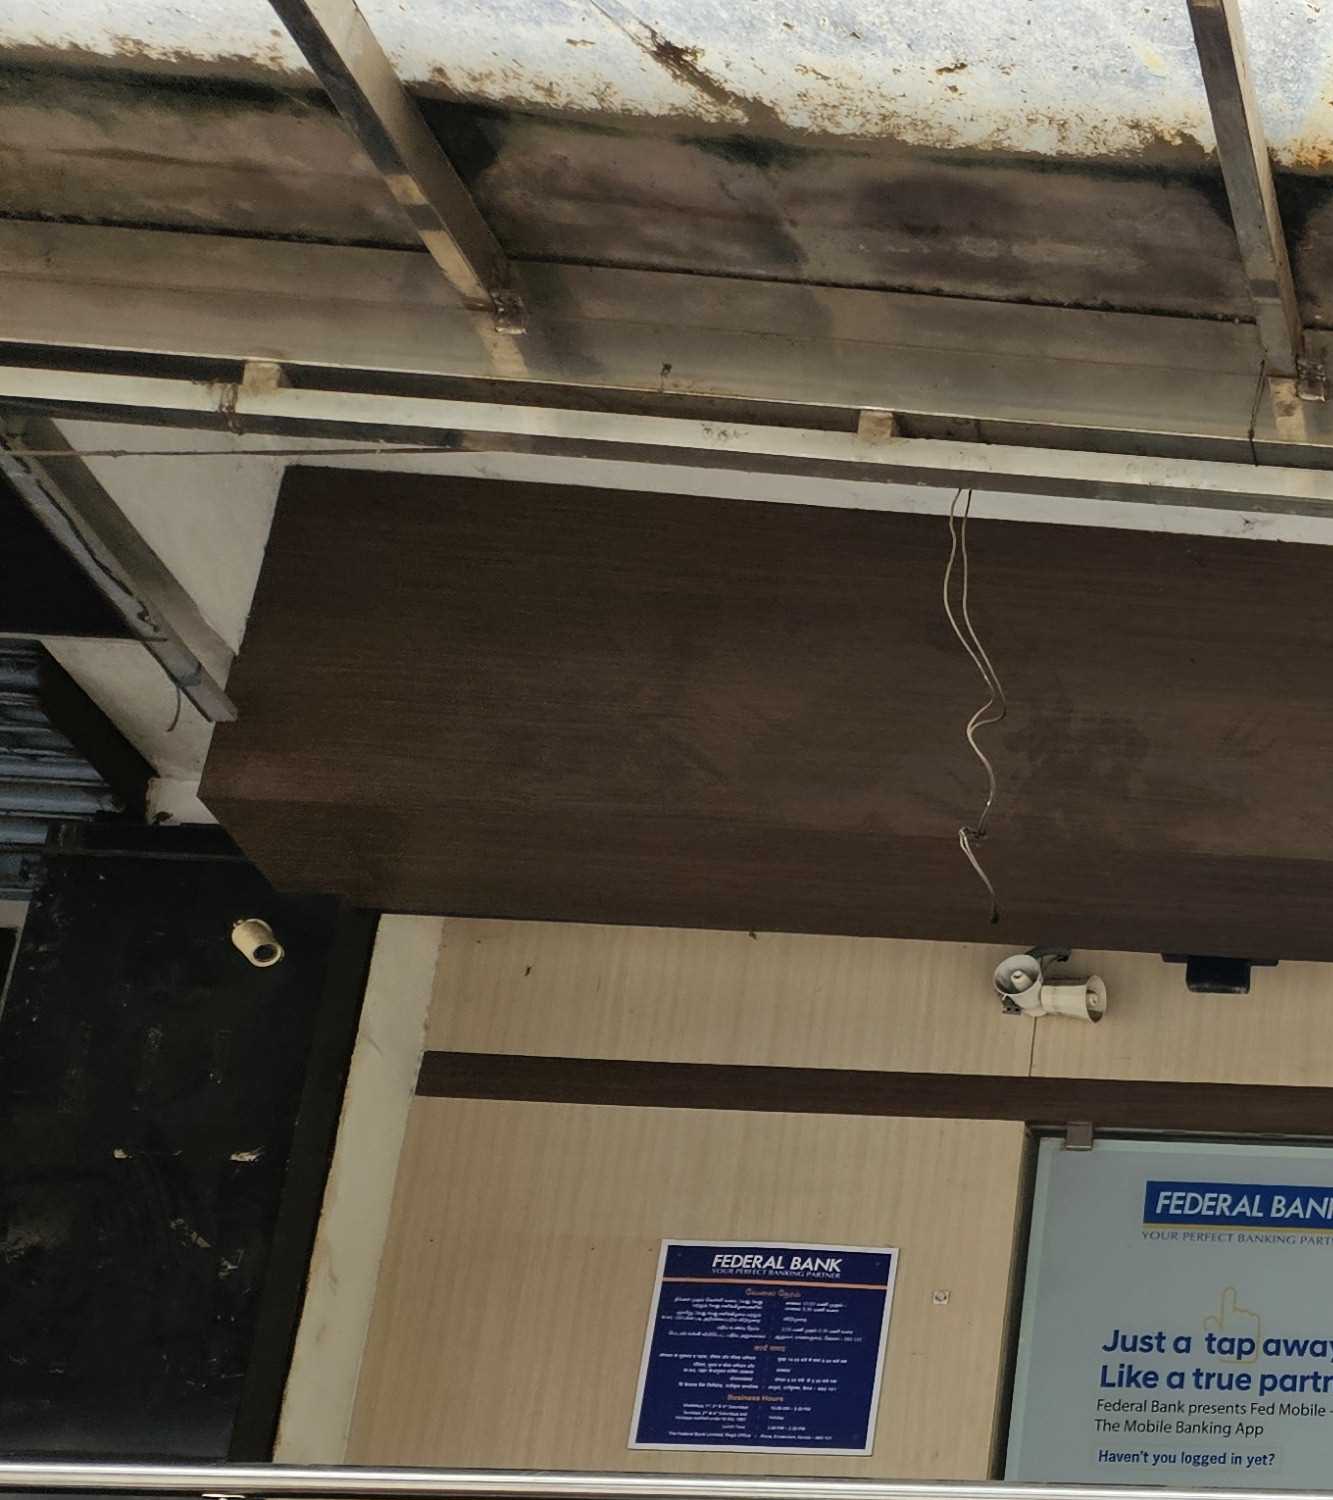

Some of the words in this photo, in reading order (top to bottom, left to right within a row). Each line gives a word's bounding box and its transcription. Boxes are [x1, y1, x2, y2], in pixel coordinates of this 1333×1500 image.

[1155, 1191, 1264, 1218] FEDERAL
[1141, 1230, 1179, 1242] YOUR
[1182, 1231, 1234, 1244] PERFECT
[1237, 1233, 1296, 1246] BANKING
[712, 1254, 785, 1271] FEDERAL
[790, 1256, 843, 1273] BANK
[1101, 1329, 1167, 1355] Just
[1173, 1335, 1192, 1355] a
[1204, 1332, 1256, 1361] tap
[1099, 1364, 1159, 1389] Like
[1166, 1371, 1185, 1391] a
[1193, 1368, 1252, 1392] true
[1097, 1398, 1147, 1414] Federal
[1151, 1399, 1185, 1415] Bank
[1188, 1401, 1247, 1418] presents
[1250, 1402, 1274, 1417] Fed
[1278, 1402, 1327, 1418] Mobile
[1094, 1418, 1120, 1434] The
[1123, 1419, 1171, 1435] Mobile
[1176, 1420, 1231, 1438] Banking
[1235, 1422, 1264, 1437] App
[1098, 1449, 1149, 1466] Haven't
[1153, 1453, 1176, 1469] you
[1180, 1450, 1227, 1470] logged
[1231, 1451, 1242, 1467] in
[1246, 1452, 1276, 1470] yet?
